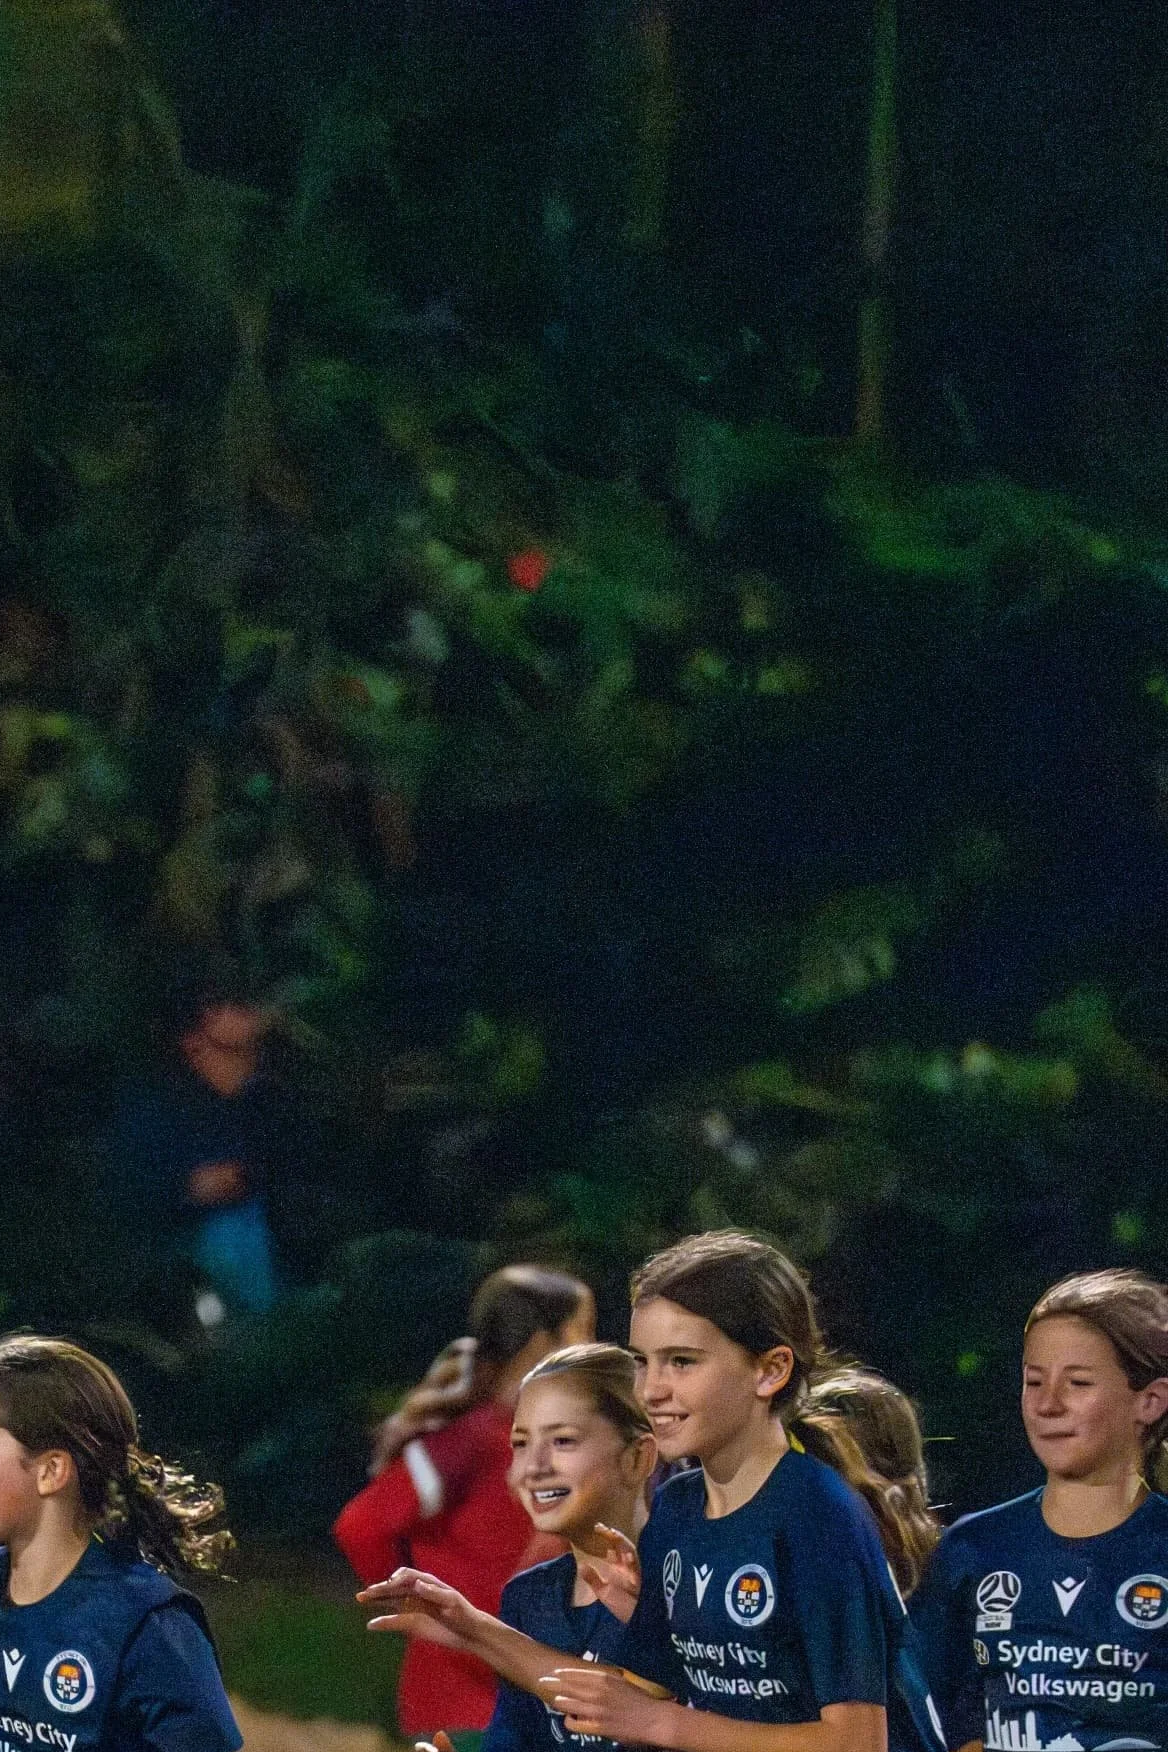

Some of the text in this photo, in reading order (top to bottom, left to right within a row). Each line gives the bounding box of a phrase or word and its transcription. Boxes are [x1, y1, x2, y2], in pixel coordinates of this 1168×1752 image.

[997, 1640, 1149, 1672] Sydney City
[1005, 1672, 1155, 1701] Volkswagen
